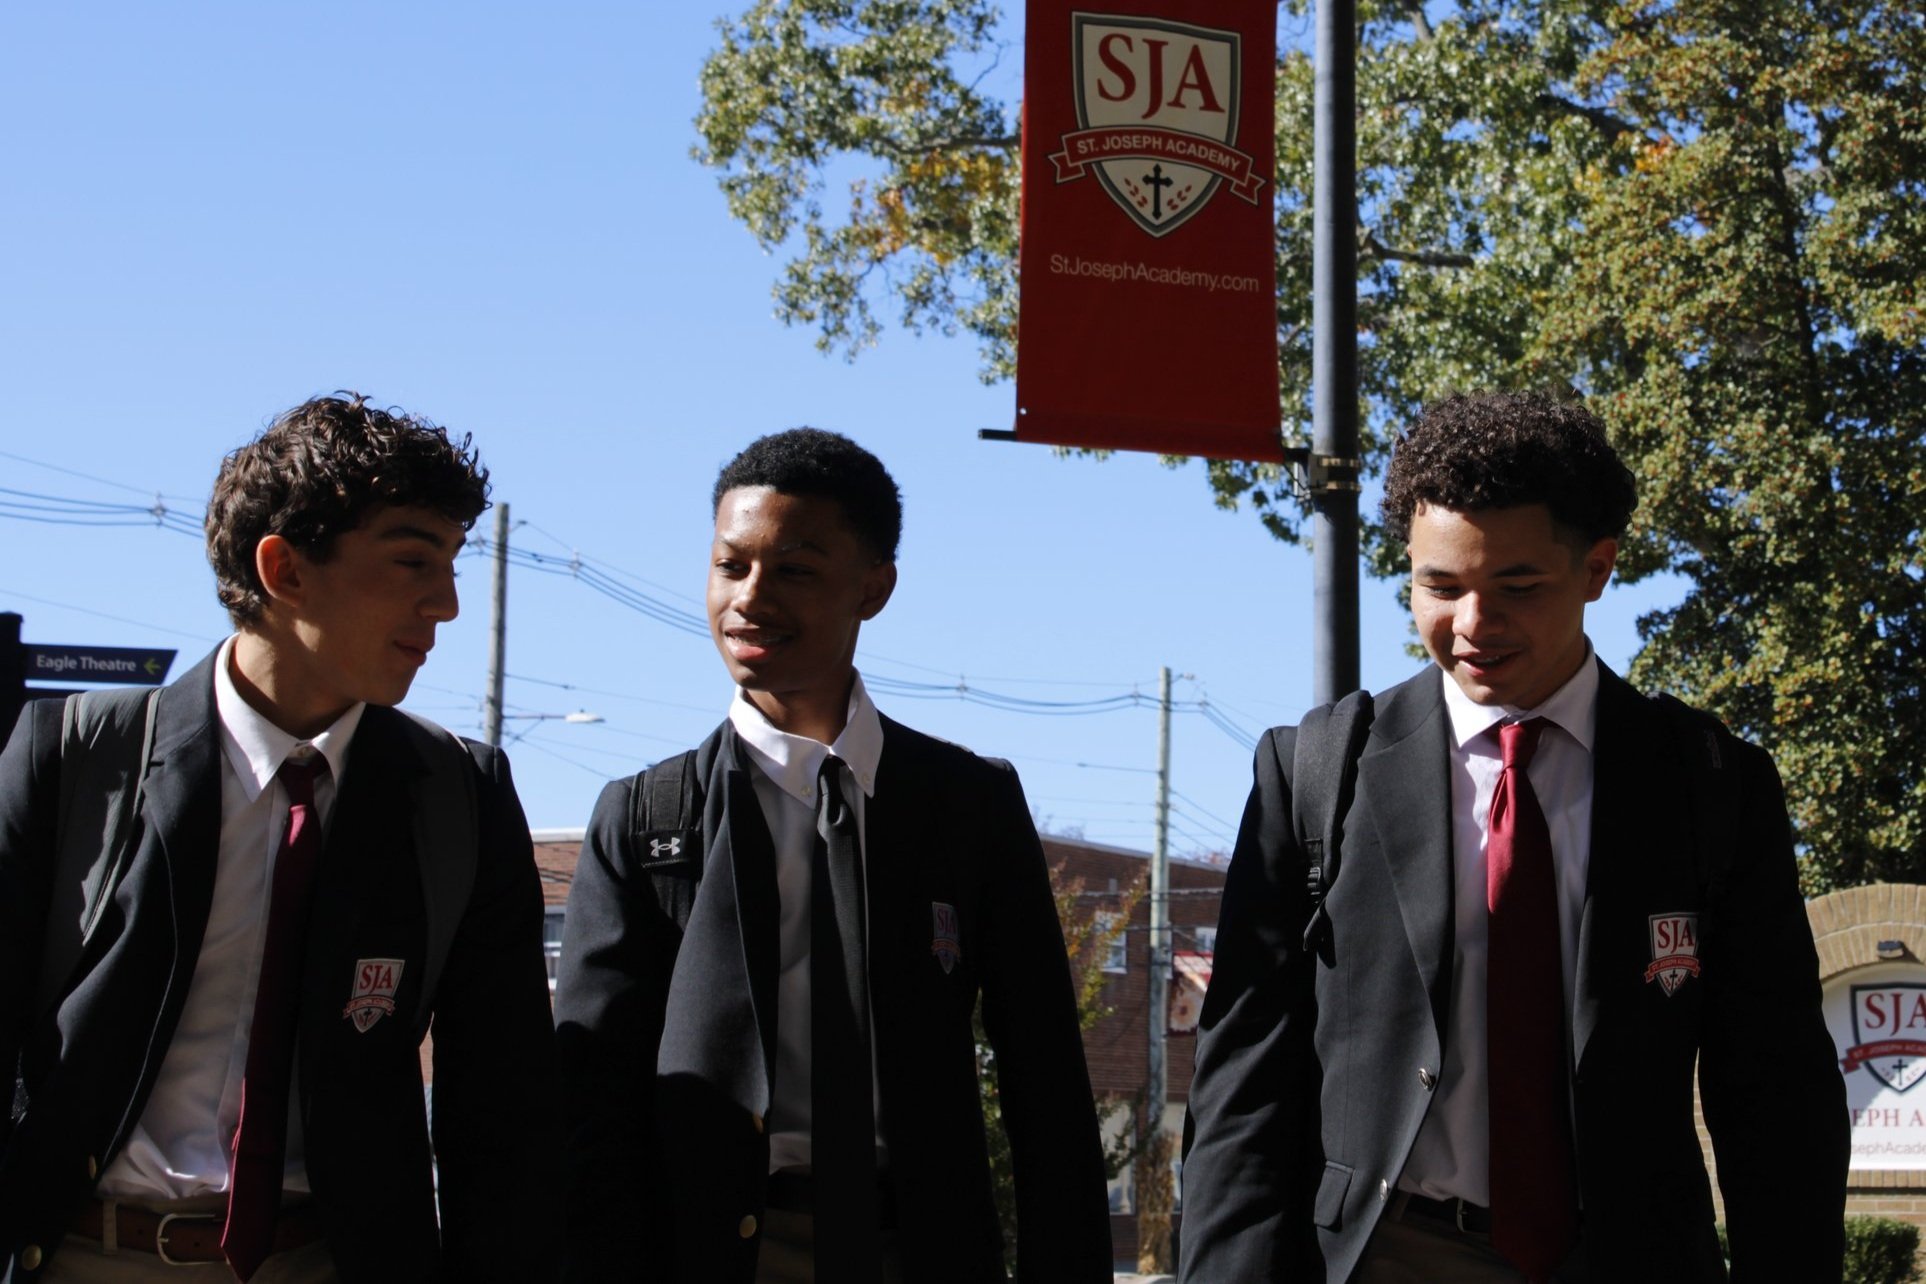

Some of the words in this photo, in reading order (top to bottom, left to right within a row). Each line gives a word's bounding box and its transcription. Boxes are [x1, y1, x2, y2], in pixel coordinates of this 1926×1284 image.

[1097, 33, 1226, 120] SJA
[1076, 138, 1099, 154] ST.
[1102, 135, 1162, 152] JOSEPH
[1165, 138, 1241, 172] ACADEMY
[1050, 254, 1259, 292] StJosephAcademy.com
[36, 654, 78, 672] Eagle
[80, 656, 137, 672] Theatre
[1657, 920, 1694, 954] SJA
[360, 964, 393, 994] SJA
[1864, 992, 1926, 1037] SJA
[1851, 1108, 1900, 1127] EPH
